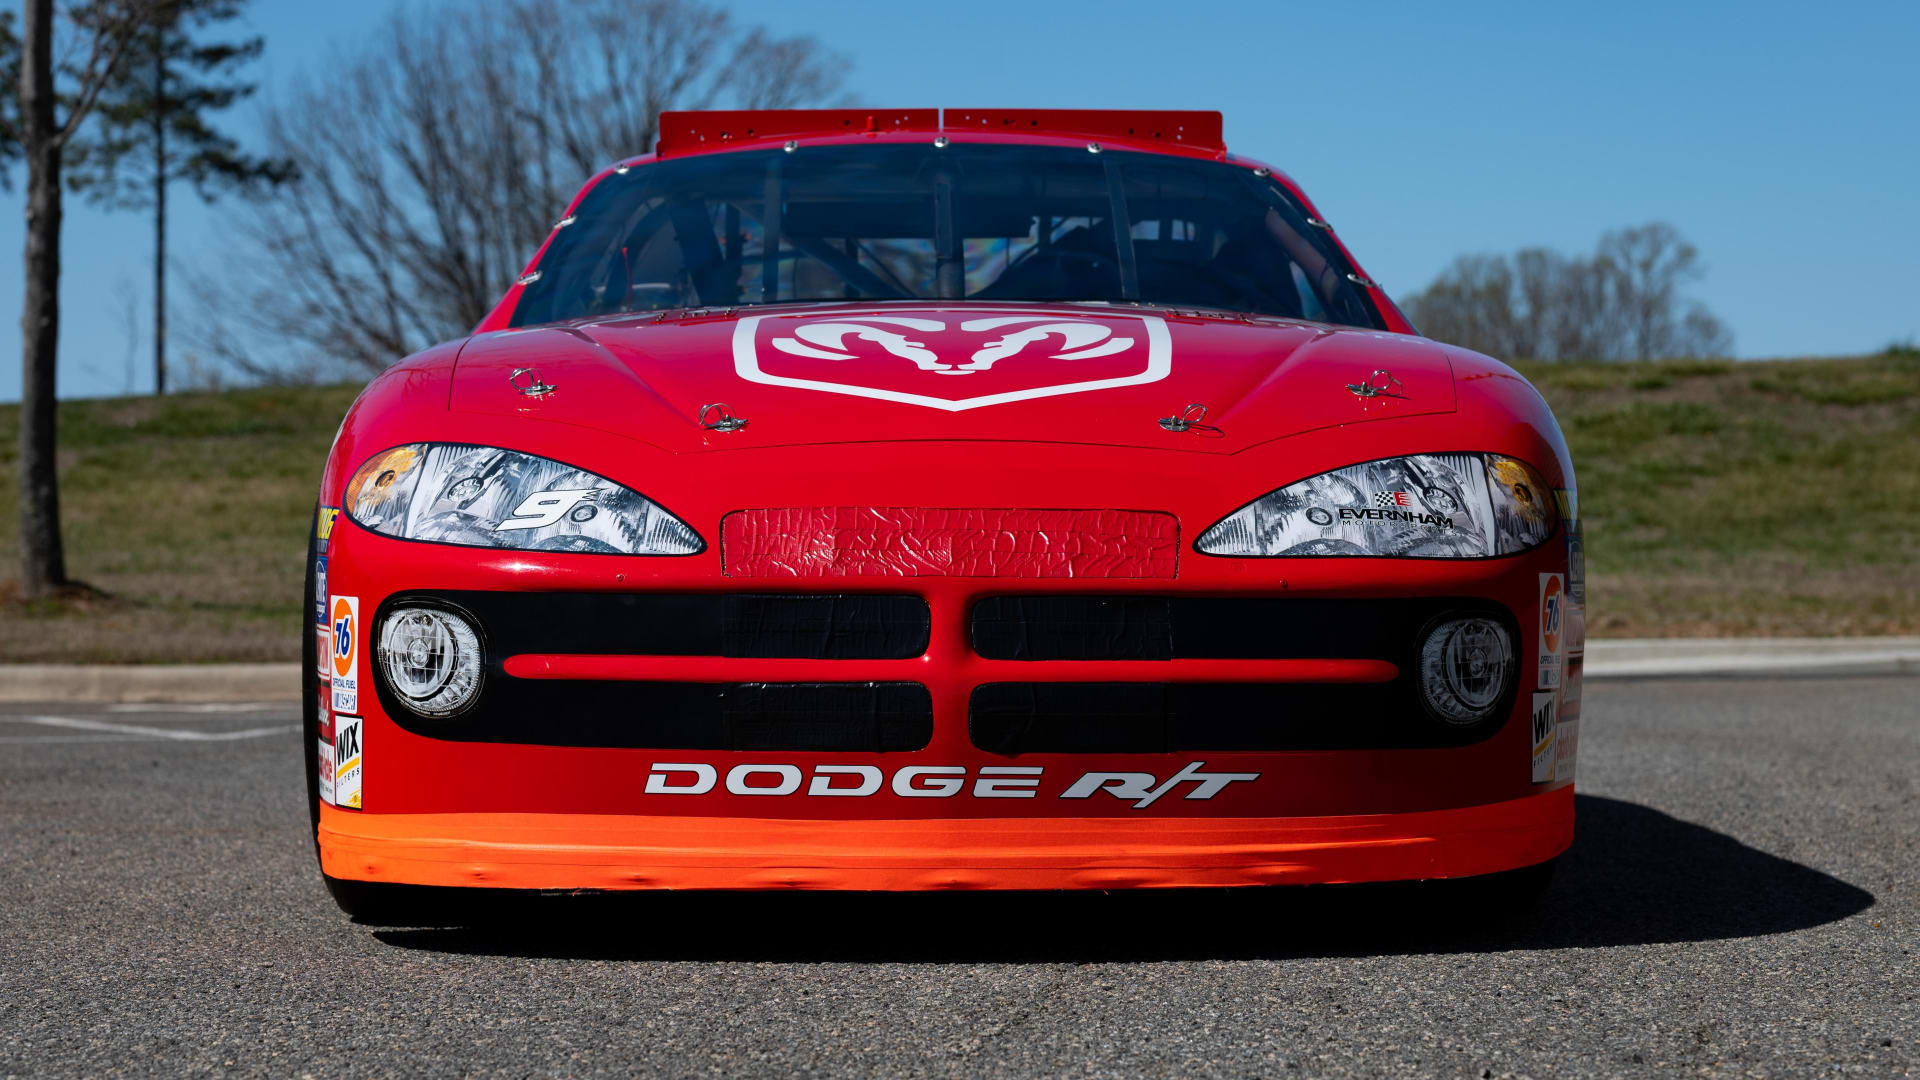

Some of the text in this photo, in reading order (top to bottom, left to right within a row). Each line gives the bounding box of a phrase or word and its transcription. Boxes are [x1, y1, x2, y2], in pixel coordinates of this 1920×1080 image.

[493, 488, 606, 532] 9
[1339, 508, 1453, 529] EVERNHAM
[334, 614, 352, 658] 76
[1546, 591, 1560, 637] 76
[346, 678, 356, 689] FUEL
[336, 721, 360, 766] WIX
[1533, 698, 1555, 745] WIX
[336, 767, 360, 789] FILTERS
[644, 761, 1261, 809] DODGE R/T
